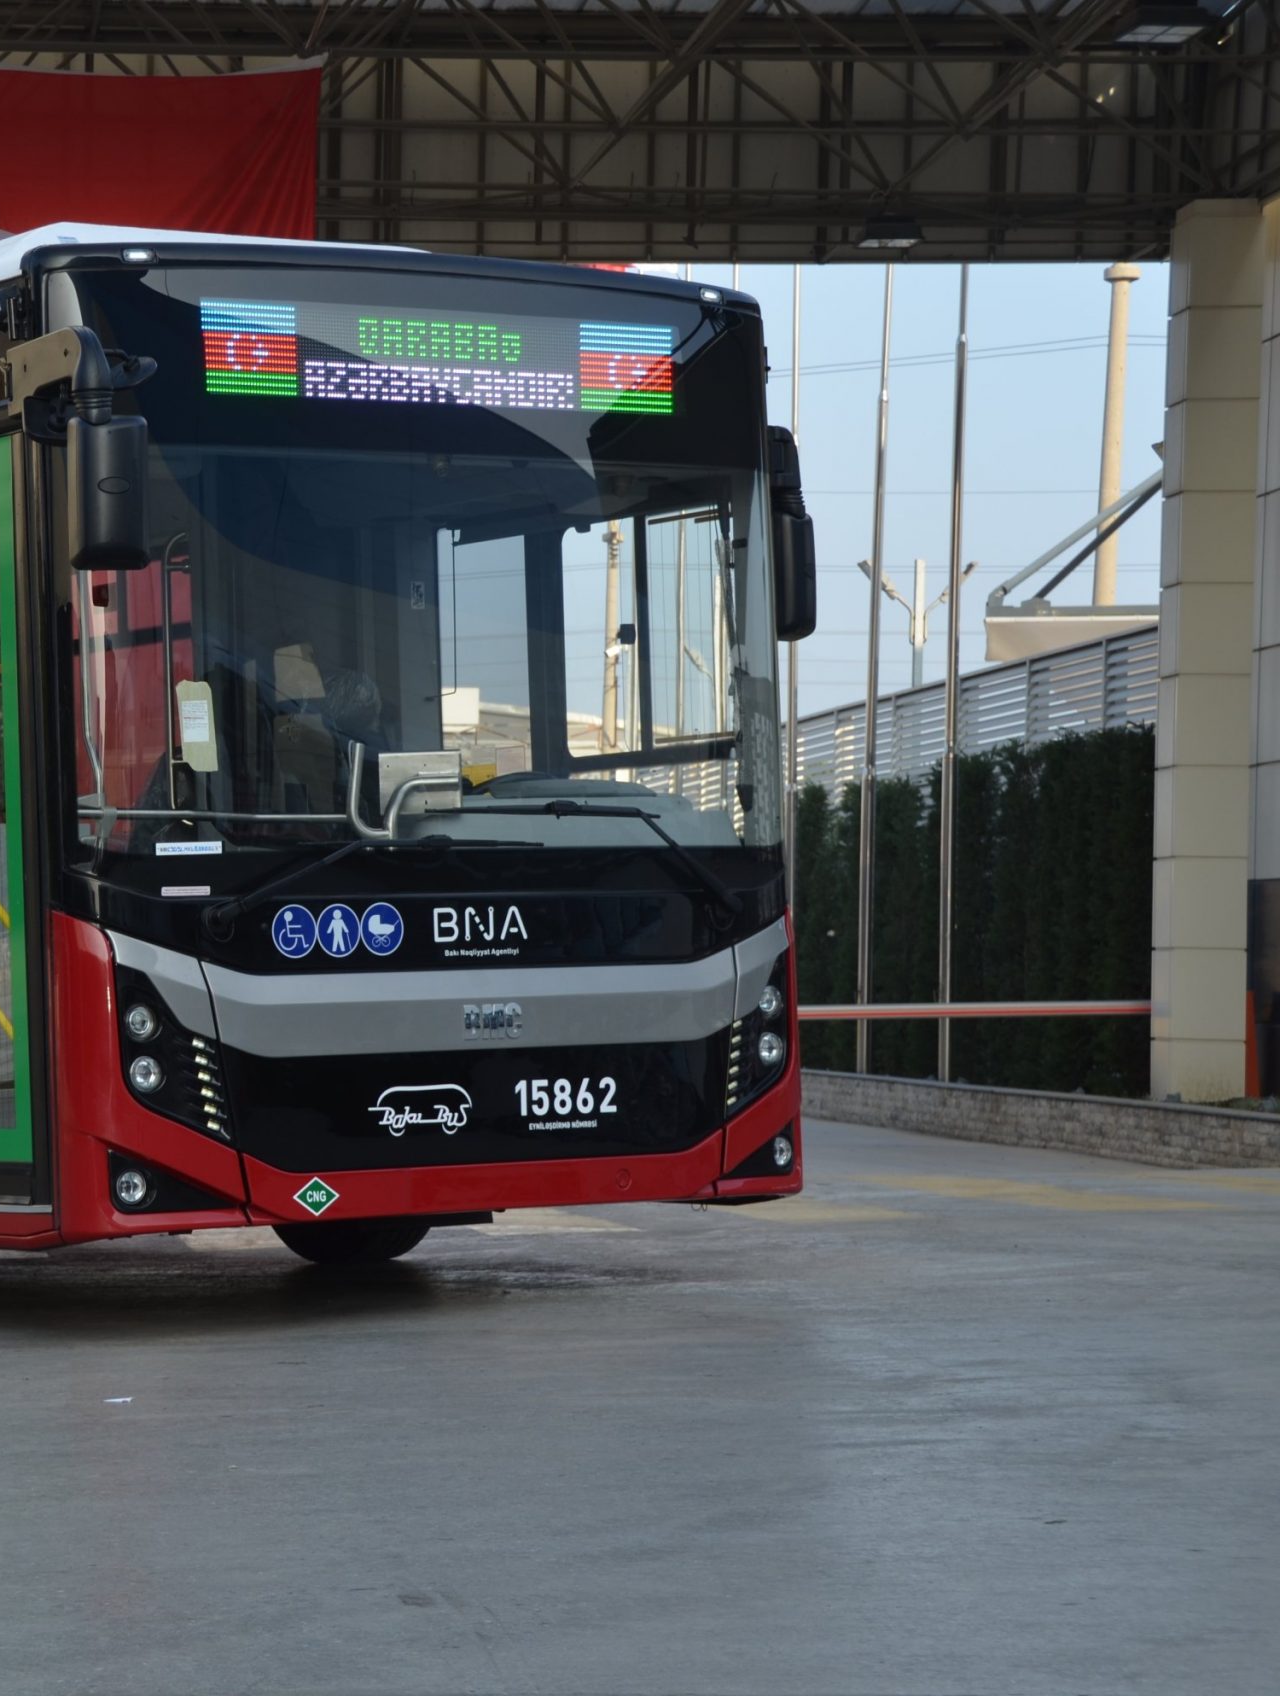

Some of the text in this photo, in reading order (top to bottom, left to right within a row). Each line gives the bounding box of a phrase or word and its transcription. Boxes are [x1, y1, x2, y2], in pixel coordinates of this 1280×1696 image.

[433, 905, 529, 943] BNA
[463, 1002, 523, 1042] BMC
[514, 1076, 618, 1117] 15862
[306, 1189, 327, 1204] CNG
